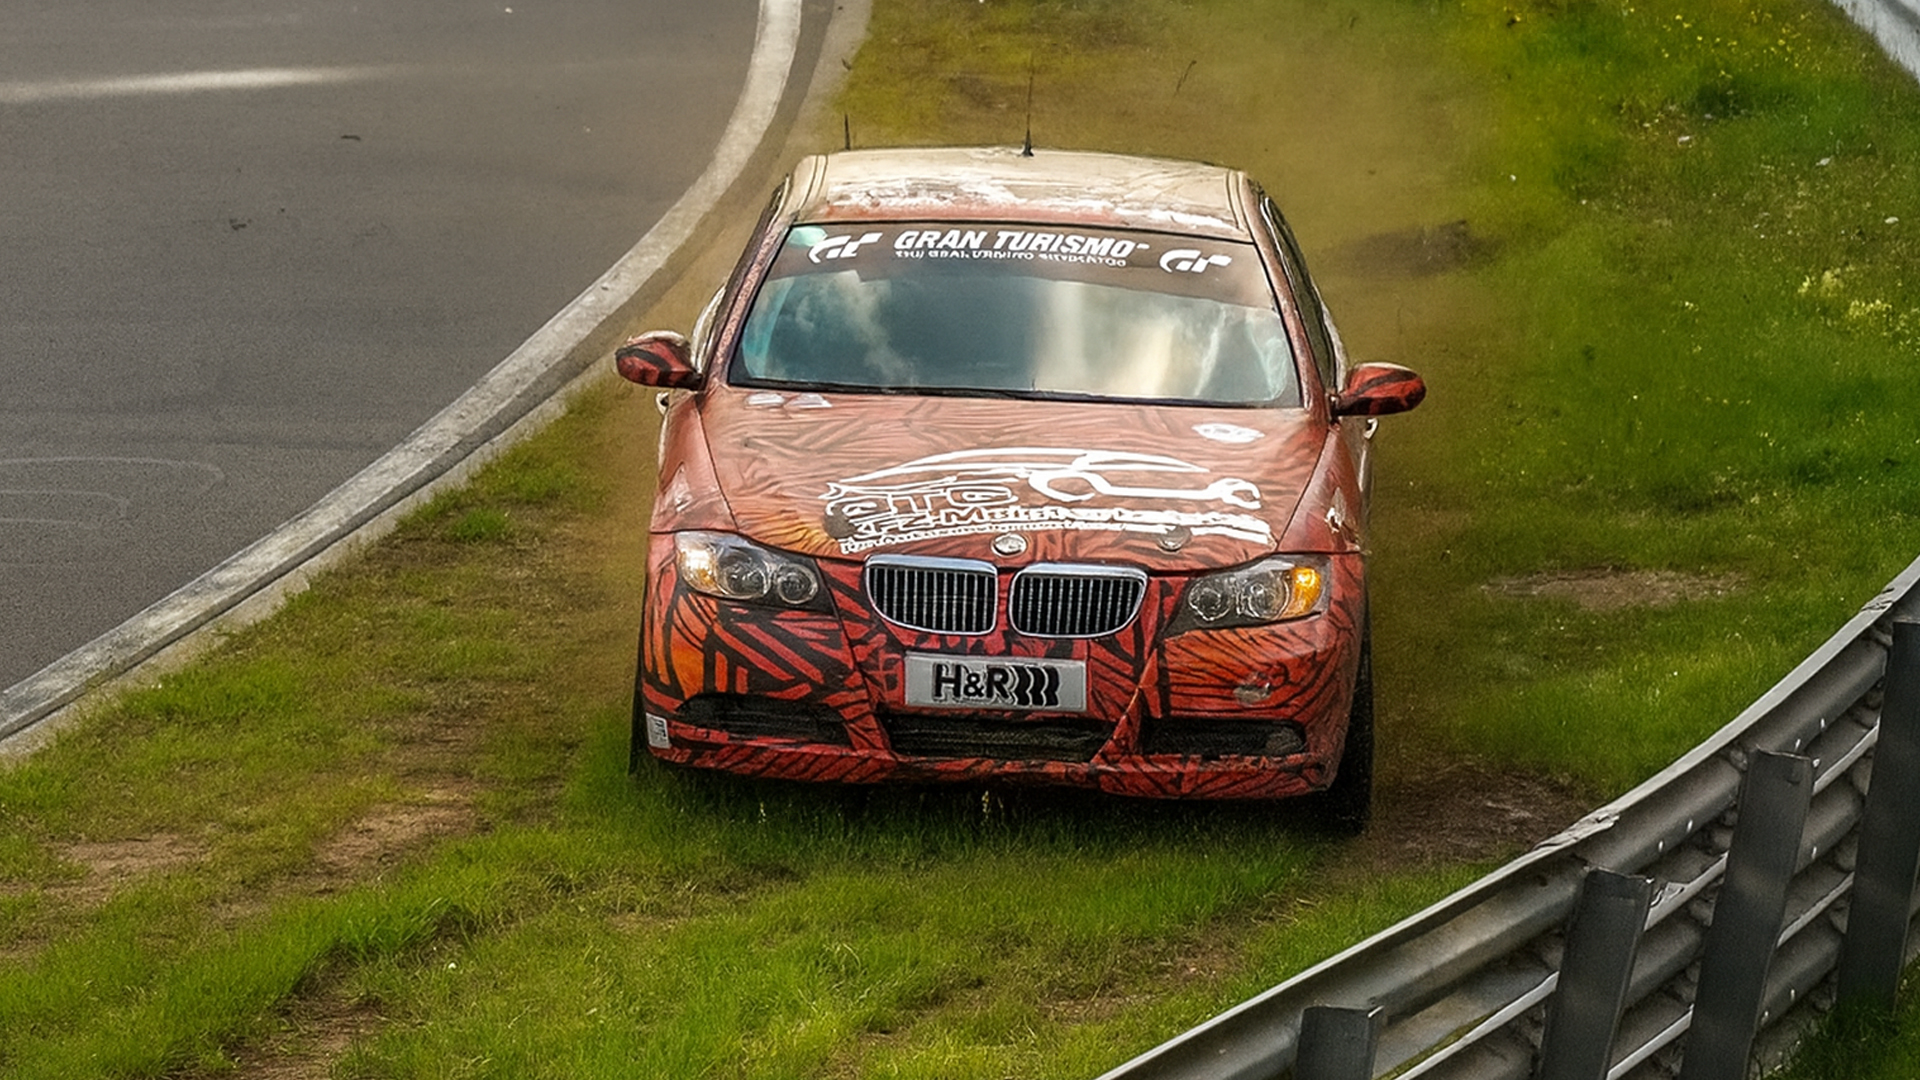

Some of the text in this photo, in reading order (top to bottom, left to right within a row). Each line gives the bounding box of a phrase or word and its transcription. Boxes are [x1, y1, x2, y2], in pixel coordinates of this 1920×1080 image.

[893, 229, 988, 250] GRAN
[993, 231, 1136, 258] TURISMO
[933, 662, 1010, 700] H&R
